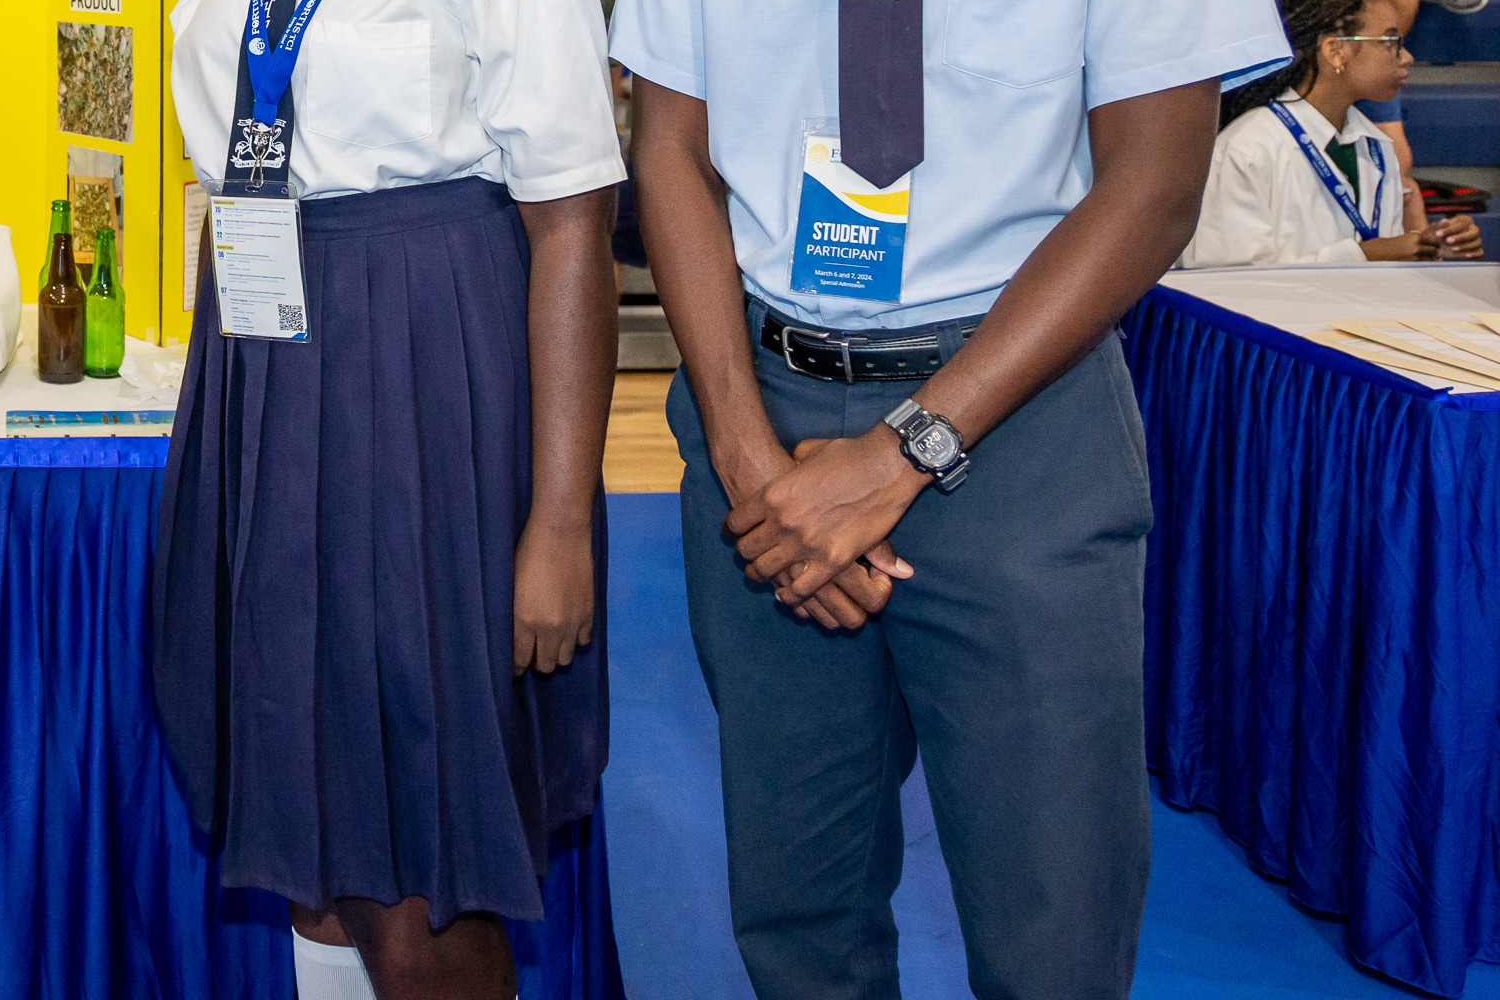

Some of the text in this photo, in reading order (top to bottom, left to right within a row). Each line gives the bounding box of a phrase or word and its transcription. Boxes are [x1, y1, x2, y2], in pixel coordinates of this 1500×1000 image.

[813, 222, 879, 245] STUDENT
[806, 244, 886, 262] PARTICIPANT
[814, 269, 833, 277] March
